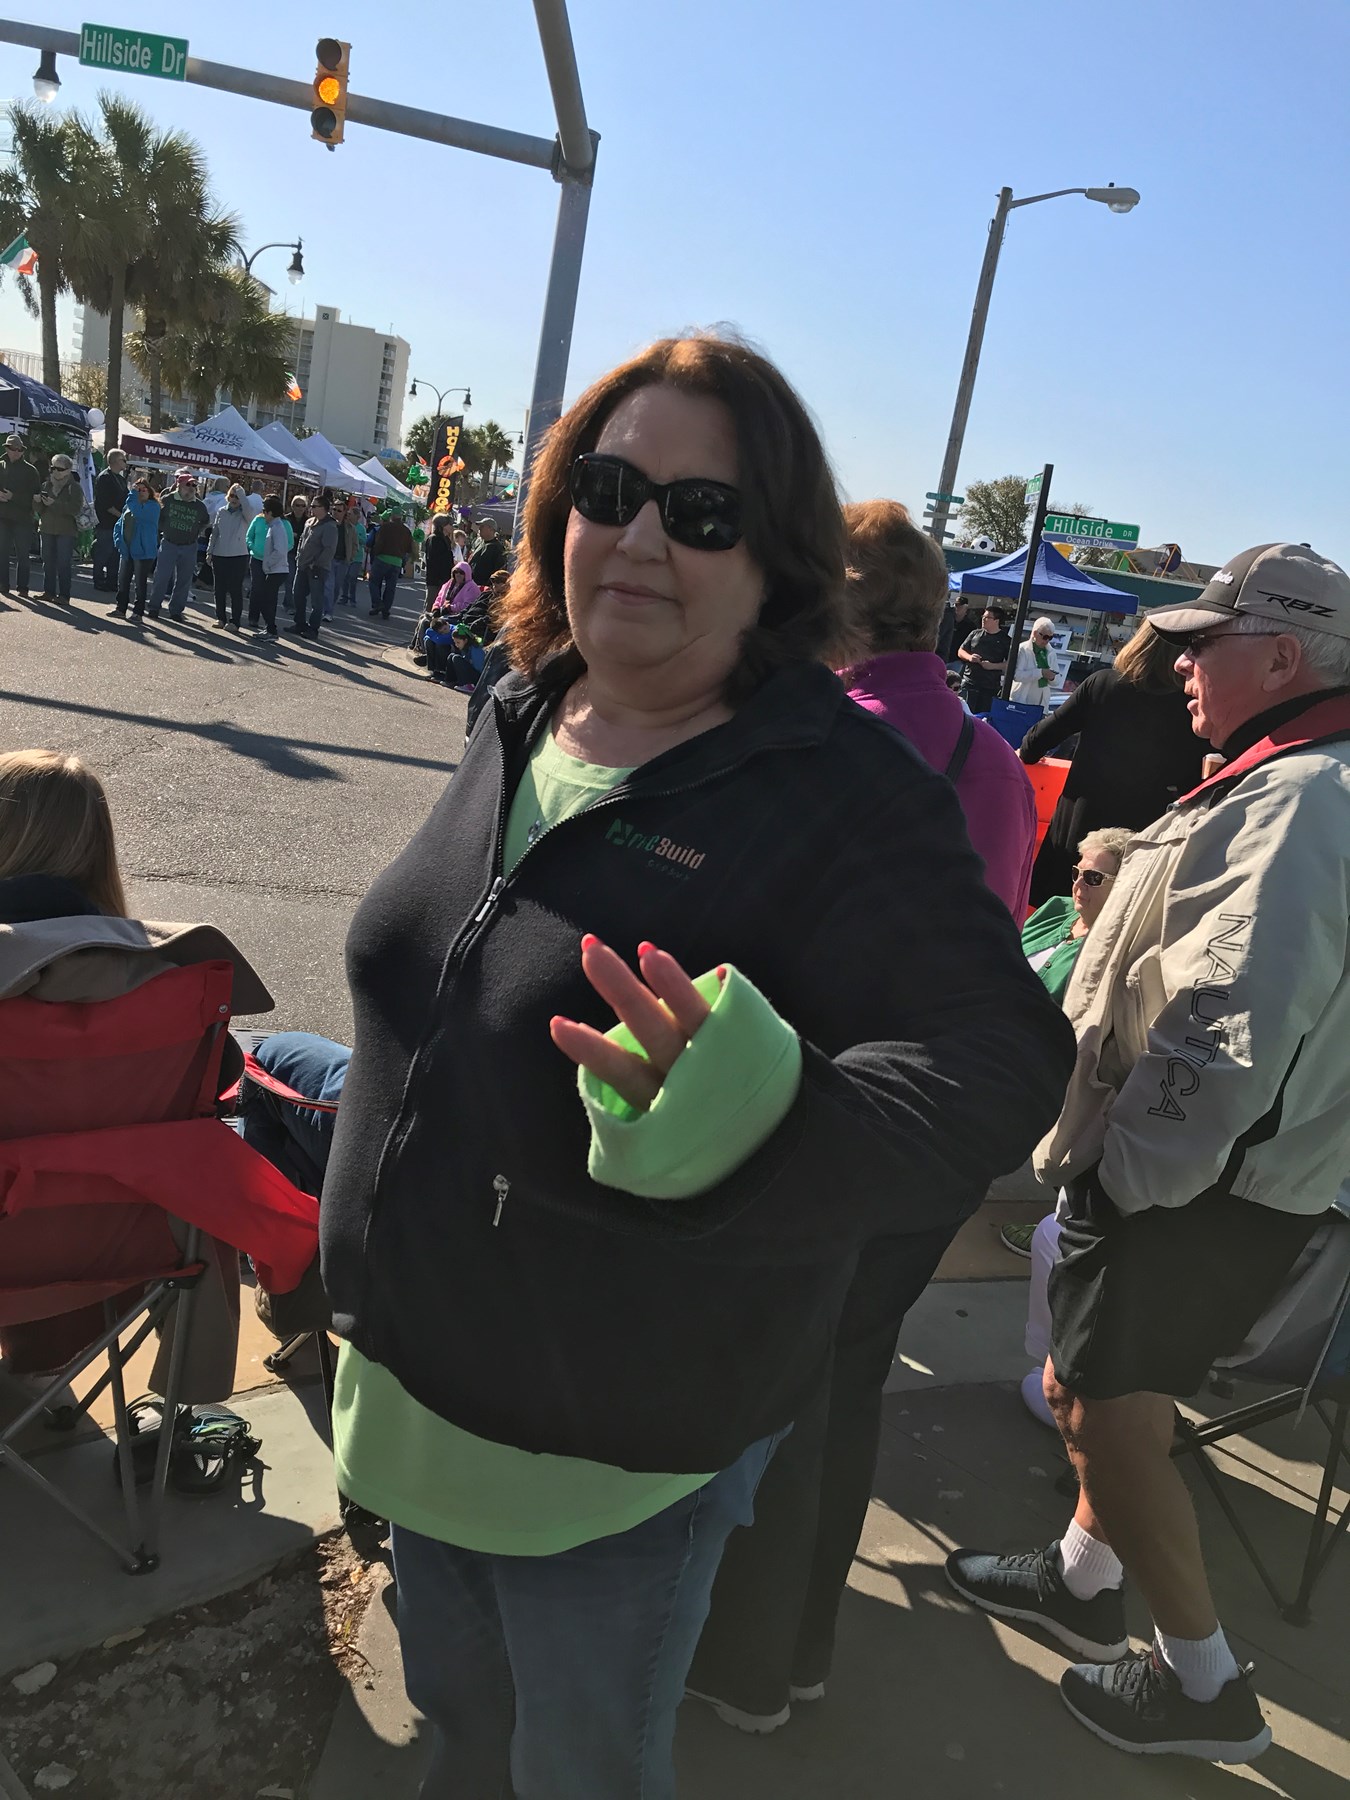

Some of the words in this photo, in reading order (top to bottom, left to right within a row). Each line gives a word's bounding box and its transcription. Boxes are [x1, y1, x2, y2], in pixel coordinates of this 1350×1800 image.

[82, 29, 151, 69] Hillside
[161, 42, 184, 74] Dr
[185, 426, 244, 441] AQUATIC
[196, 432, 243, 448] FITNESS
[446, 426, 460, 456] HOT
[145, 444, 264, 472] www.nmb.us/afc
[1053, 518, 1114, 538] Hillside
[1122, 529, 1133, 538] DR
[1066, 535, 1091, 546] Ocean
[1093, 538, 1114, 549] Drive
[1257, 590, 1337, 618] RBZ
[1147, 913, 1252, 1121] NAUTICA
